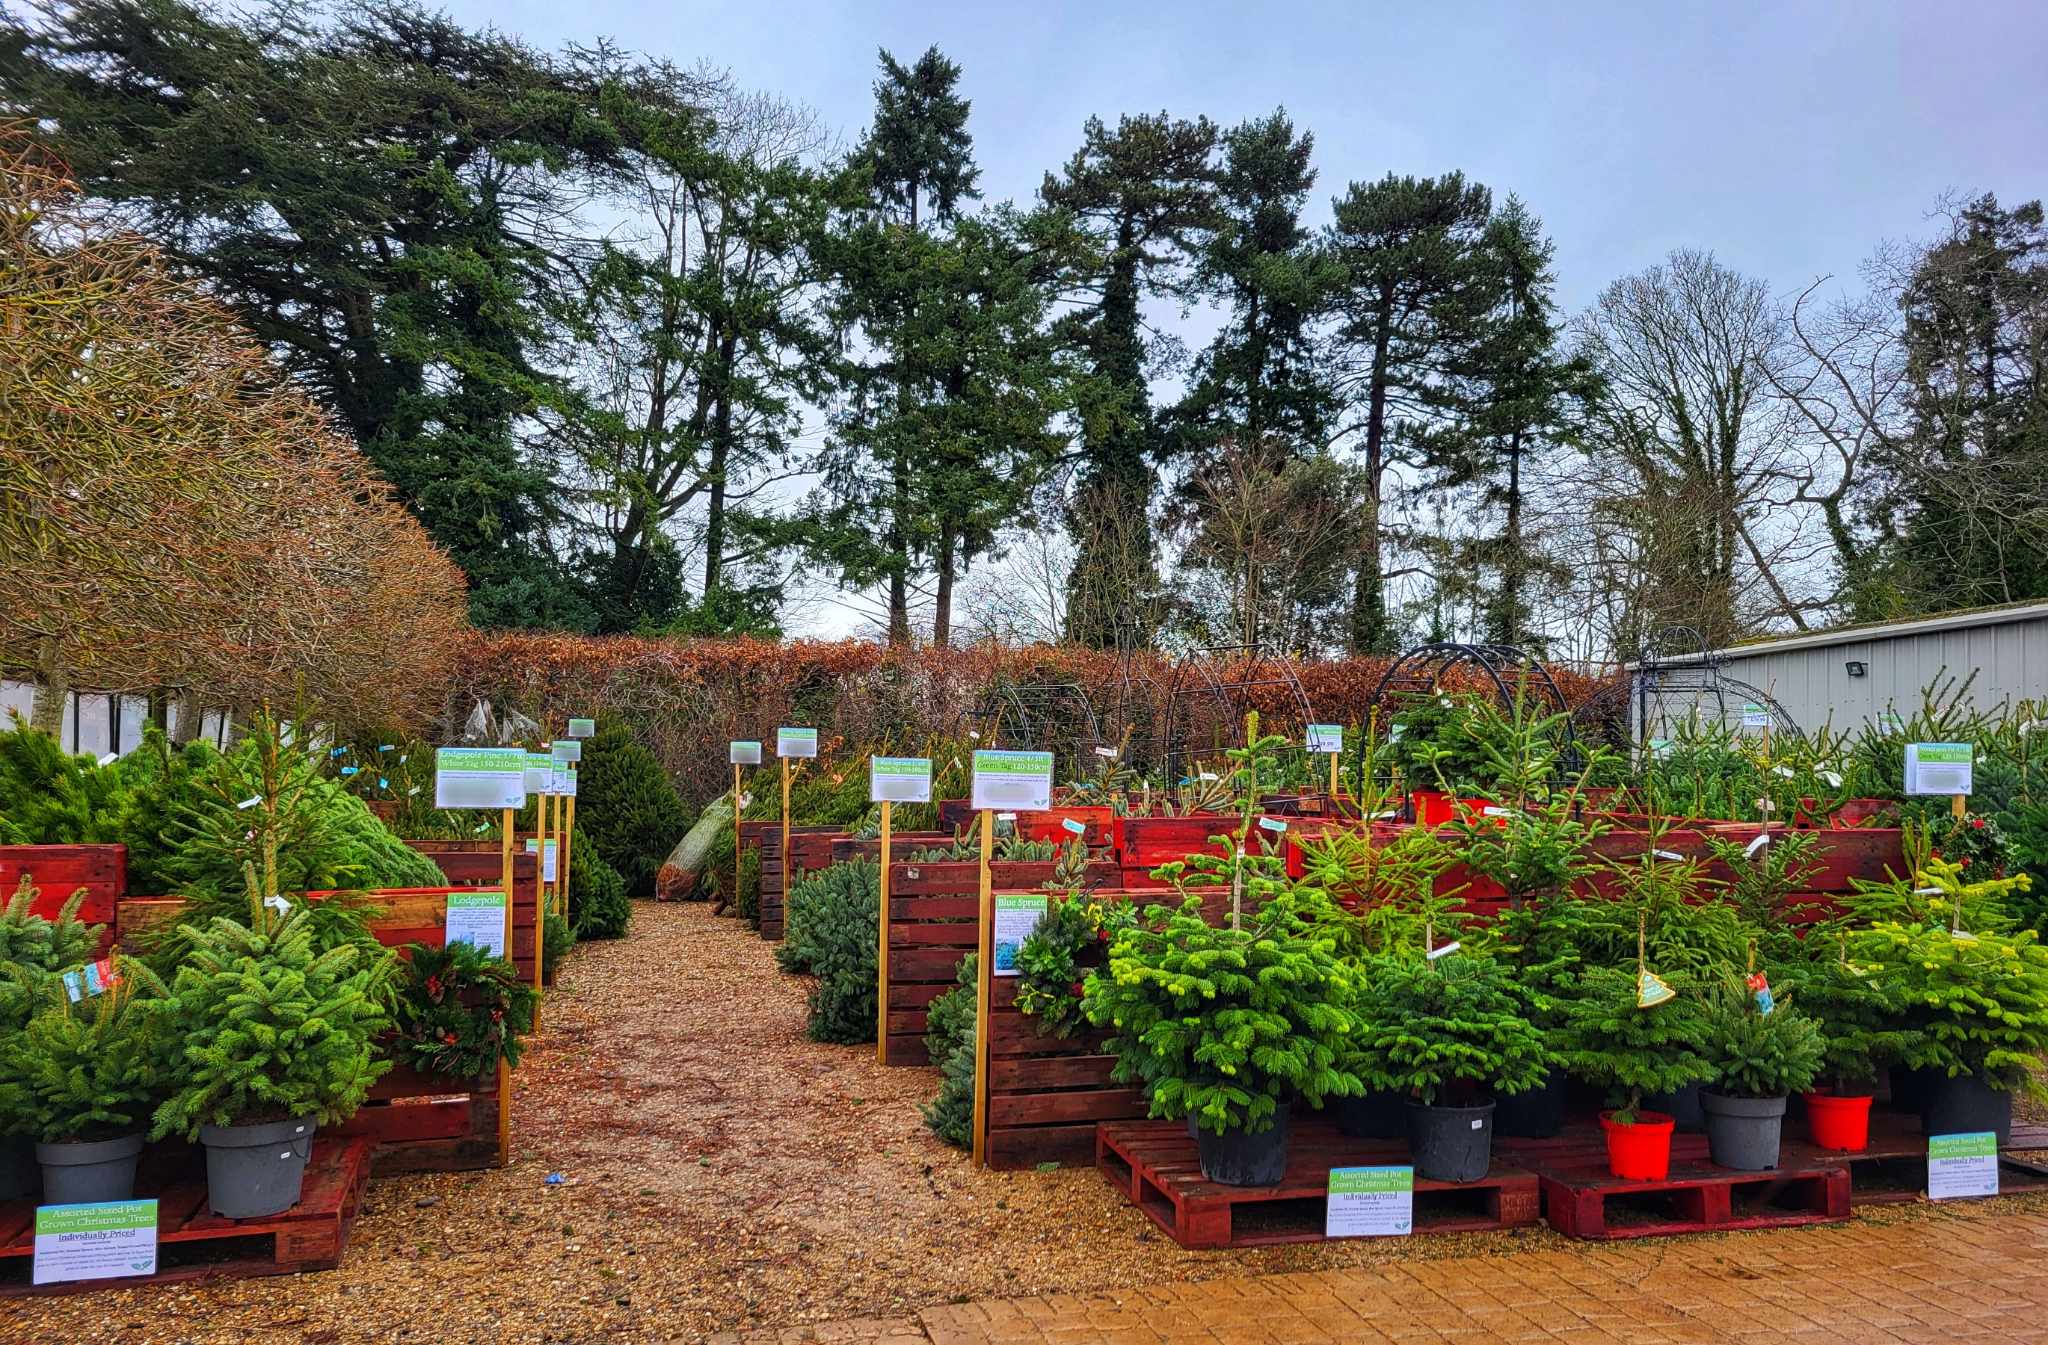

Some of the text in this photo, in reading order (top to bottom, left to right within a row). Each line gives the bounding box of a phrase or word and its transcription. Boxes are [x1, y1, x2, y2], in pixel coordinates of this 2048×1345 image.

[441, 751, 481, 760] Lodgepole
[484, 751, 502, 759] Pine
[977, 761, 998, 769] Green
[1001, 762, 1012, 770] Tag
[454, 896, 500, 906] Lodgepole
[999, 898, 1045, 909] Blue Spruce
[1379, 1192, 1398, 1200] Priced
[53, 1208, 95, 1218] Assorted
[127, 1205, 143, 1214] Pot
[40, 1214, 155, 1230] Grown Christmas Trees
[59, 1230, 136, 1242] Individually Priced
